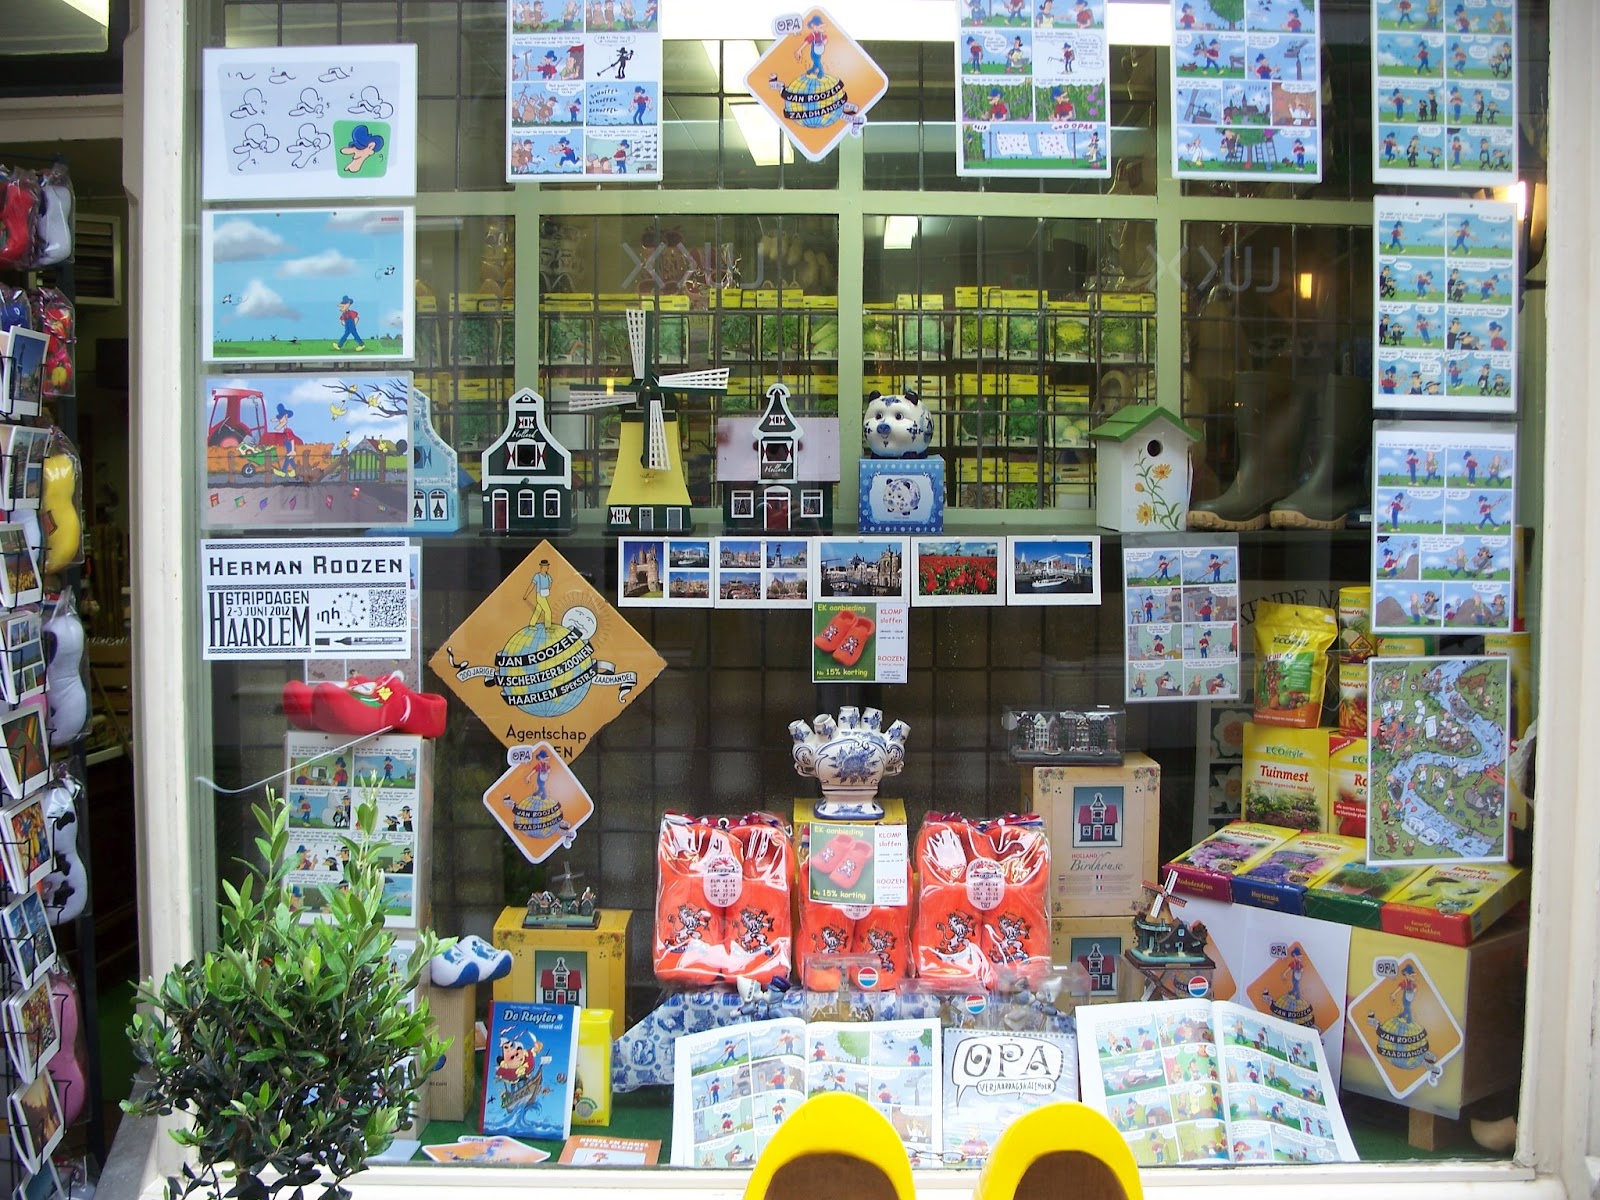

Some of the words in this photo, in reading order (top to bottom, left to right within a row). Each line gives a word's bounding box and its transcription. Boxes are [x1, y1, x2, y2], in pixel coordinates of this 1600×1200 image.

[776, 18, 800, 32] OPA
[787, 94, 804, 103] JAN
[808, 84, 841, 102] ROOZEN
[789, 99, 846, 119] ZAADHANDEL
[512, 428, 538, 439] Holland
[764, 463, 791, 473] Holland
[210, 556, 302, 576] HERMAN
[313, 556, 402, 574] ROOZEN
[225, 590, 310, 606] STRIPDAGEN
[246, 606, 268, 616] JUNI
[270, 606, 290, 616] 2012
[818, 604, 827, 612] EK
[830, 604, 866, 614] aanbieding
[208, 592, 311, 648] HAARLEM
[498, 654, 523, 667] JAN
[528, 631, 579, 664] ROOZEN
[826, 668, 841, 676] 15%
[843, 668, 868, 677] korting
[594, 674, 634, 684] ZAADHANDEL
[508, 688, 558, 706] HAARLEM
[506, 724, 586, 742] Agentschap
[512, 750, 531, 761] OPA
[1266, 746, 1304, 758] ECOstyle
[1260, 764, 1309, 782] Tuinmest
[516, 809, 530, 818] JAN
[532, 804, 560, 818] ROOZEN
[826, 828, 864, 837] aanbieding
[1070, 852, 1124, 871] Birdhouse
[840, 891, 867, 900] korting
[1251, 890, 1280, 902] Hortensia
[1404, 924, 1419, 932] tegen
[1420, 927, 1440, 936] slakken
[1270, 946, 1287, 956] OPA
[1377, 963, 1396, 974] OPA
[520, 1010, 558, 1024] Ruyter
[1274, 1008, 1286, 1017] JAN
[1288, 1008, 1312, 1018] ROOZEN
[1380, 1033, 1395, 1042] JAN
[1397, 1032, 1425, 1044] ROOZEN
[1381, 1045, 1427, 1058] ZAADHANDEL
[963, 1043, 1052, 1078] OPA
